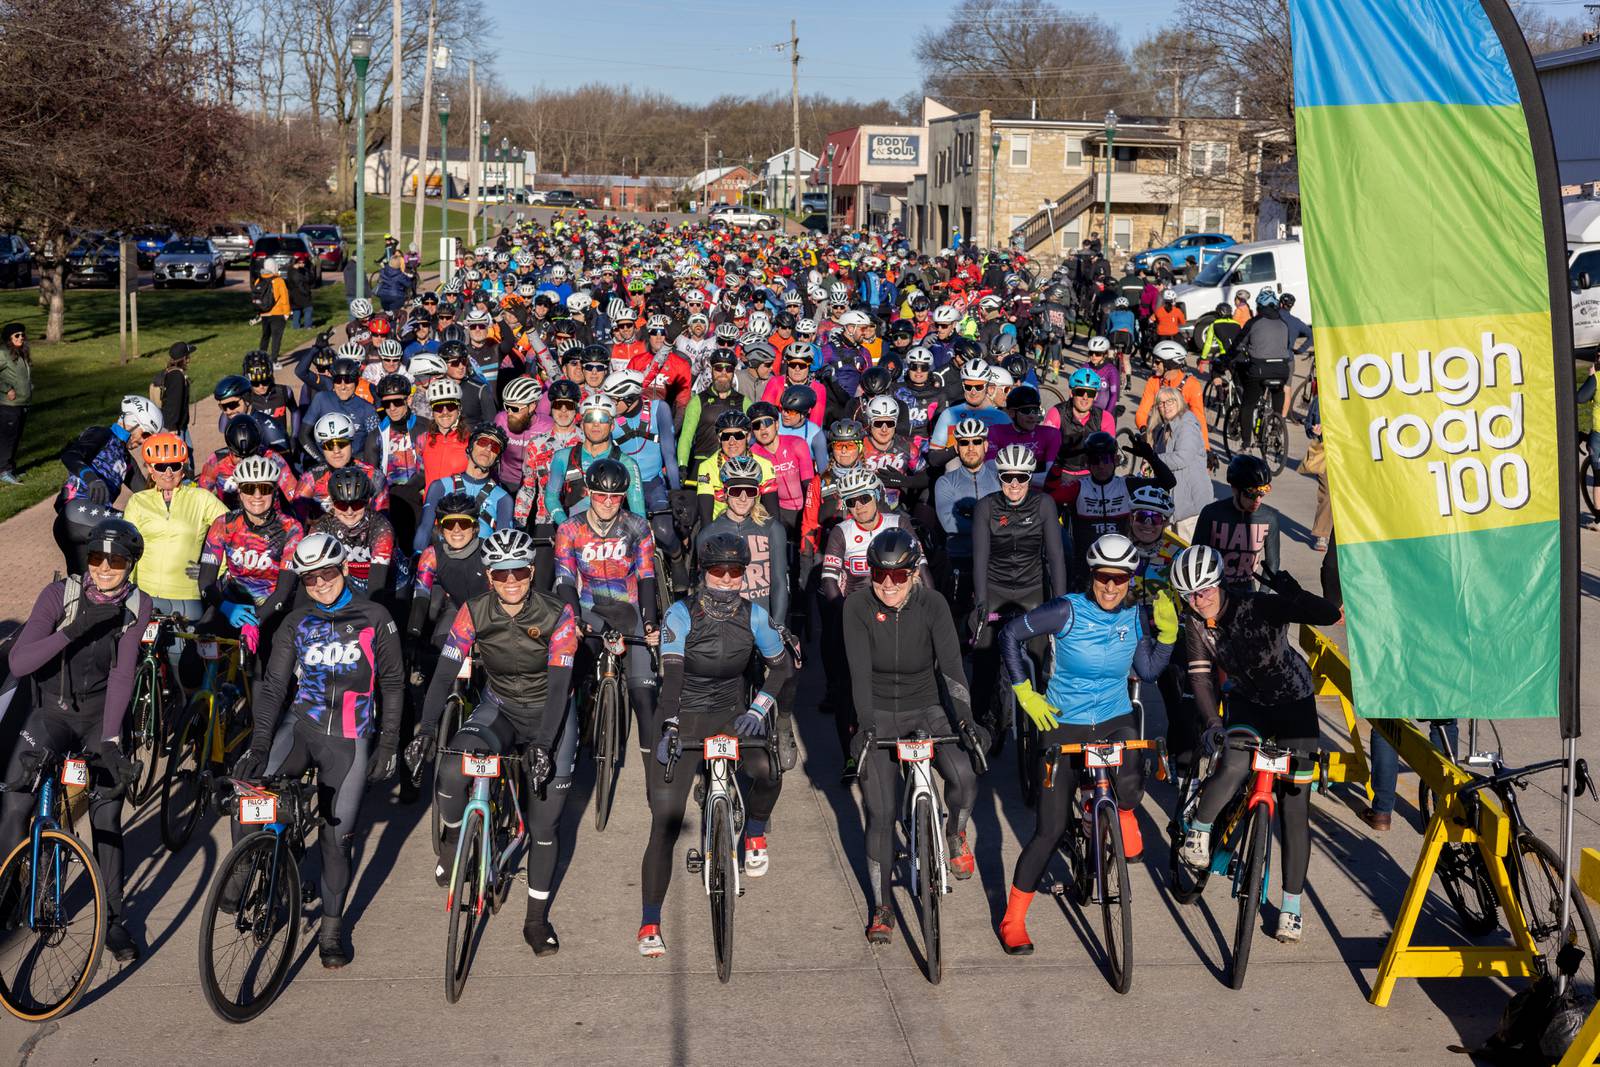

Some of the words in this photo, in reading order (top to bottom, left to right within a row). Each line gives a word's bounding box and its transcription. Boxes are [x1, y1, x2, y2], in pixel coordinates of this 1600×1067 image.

[876, 137, 908, 146] BODY
[887, 147, 914, 156] SOUL
[1335, 332, 1524, 406] rough
[908, 407, 928, 421] 06
[1369, 392, 1524, 461] road
[774, 461, 795, 472] PEX
[1428, 453, 1530, 516] 100
[1210, 520, 1270, 552] HALF
[581, 536, 628, 562] 606
[232, 546, 273, 570] 606
[304, 640, 361, 666] 606
[717, 743, 727, 753] 26
[912, 750, 918, 758] 8
[475, 764, 486, 774] 20
[255, 806, 260, 818] 3
